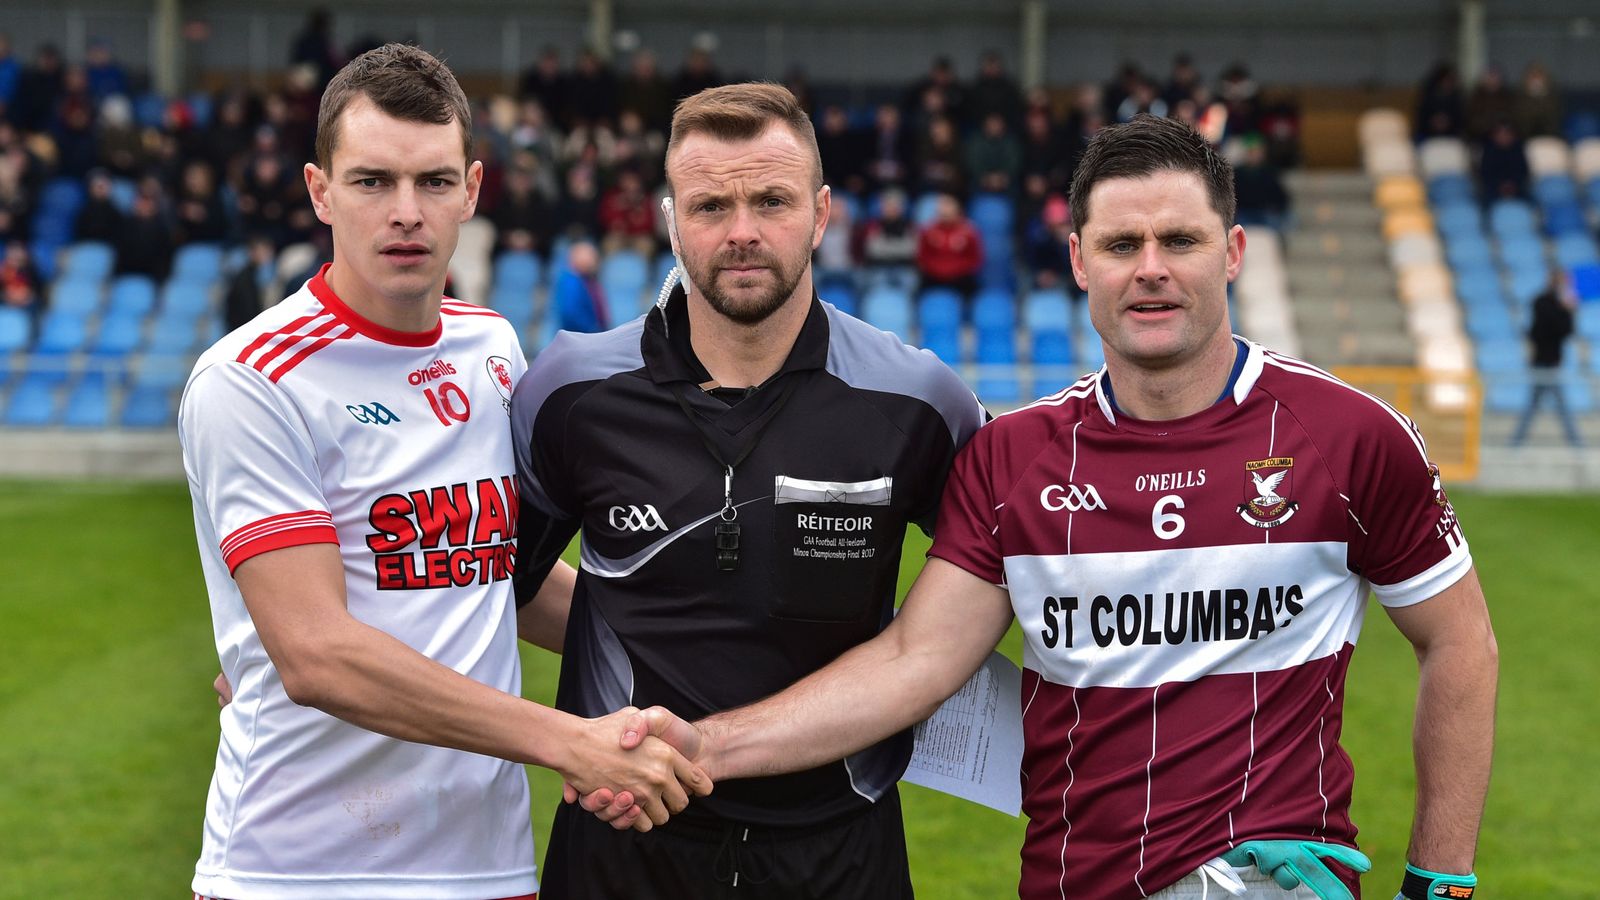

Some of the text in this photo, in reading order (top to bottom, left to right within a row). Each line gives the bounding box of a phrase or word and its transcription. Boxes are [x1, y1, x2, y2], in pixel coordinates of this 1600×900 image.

[423, 381, 471, 427] 10
[1266, 458, 1291, 467] COLUMBA
[1135, 469, 1206, 492] O'NEILLS
[1040, 484, 1107, 512] GAA
[365, 474, 519, 553] SWAN
[608, 504, 669, 532] GAA
[797, 512, 873, 532] RÉITEOIR
[1152, 494, 1186, 540] 6
[793, 547, 875, 561] Minor Championship Final 2017
[803, 535, 866, 547] GAA Football All-Ireland
[1041, 584, 1304, 649] ST COLUMBA'S
